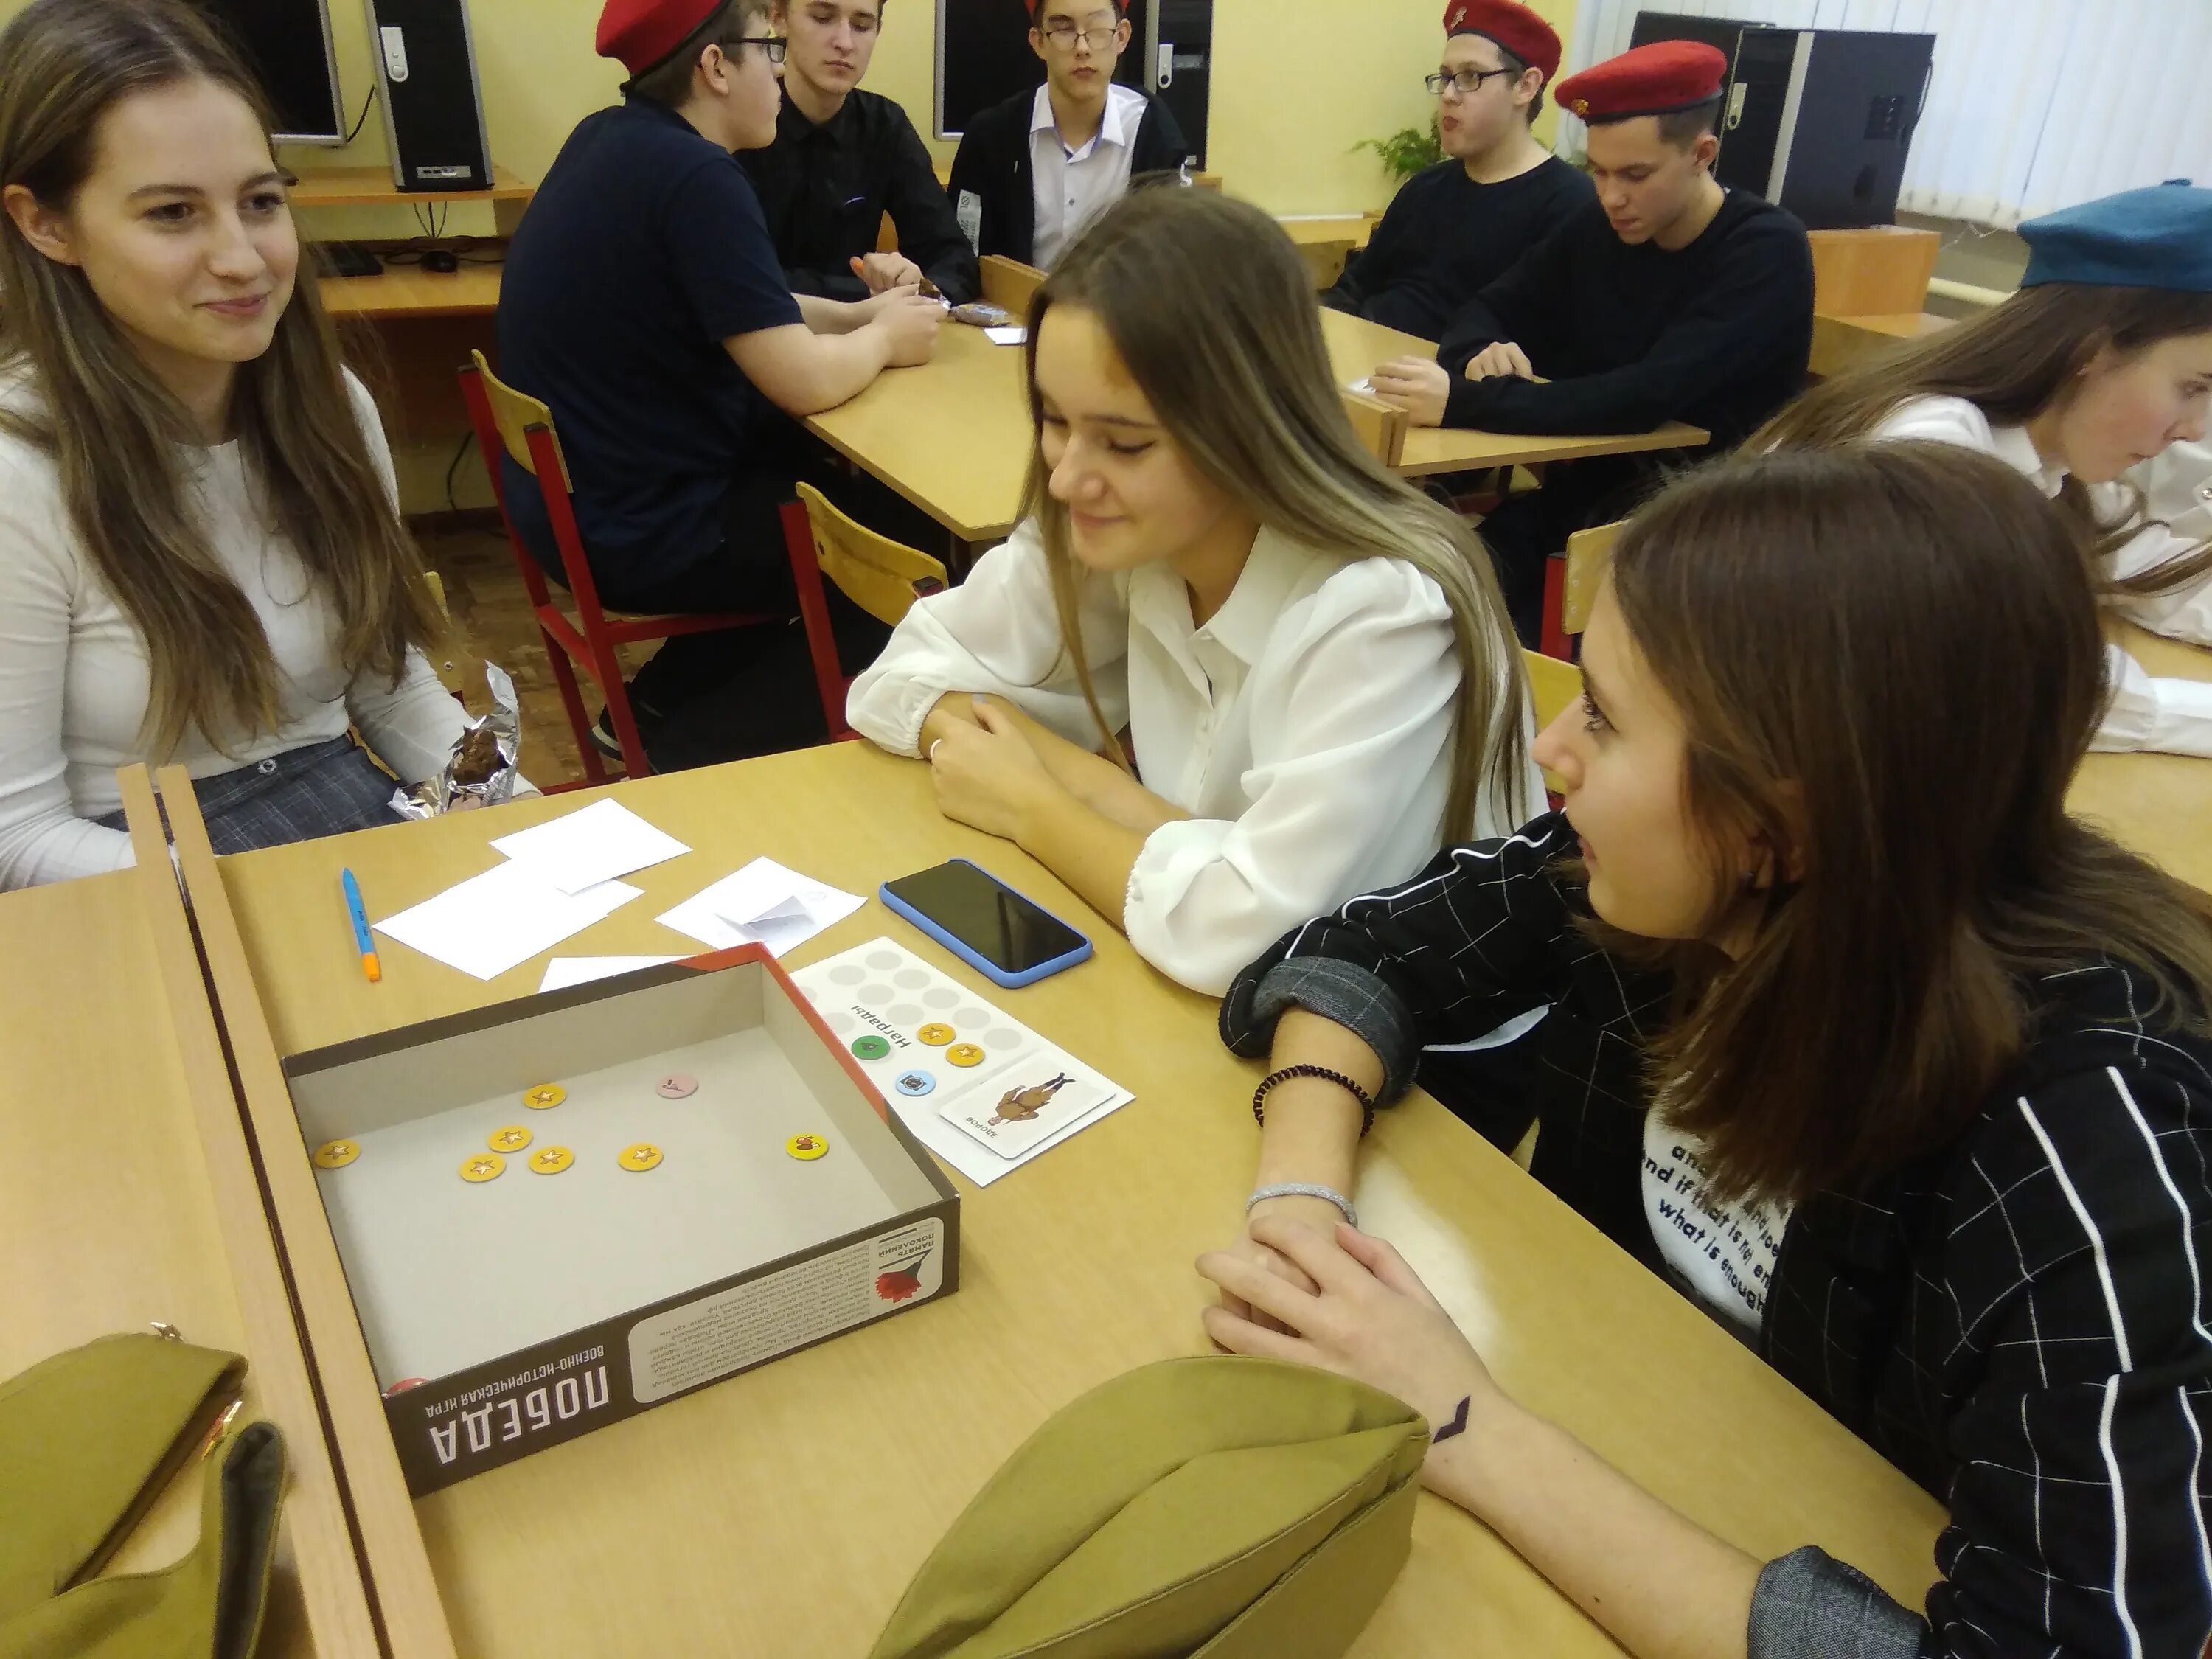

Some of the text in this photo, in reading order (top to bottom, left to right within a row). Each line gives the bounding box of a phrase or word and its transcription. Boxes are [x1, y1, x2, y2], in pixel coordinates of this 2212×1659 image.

[849, 1005, 912, 1049] Награды
[966, 1116, 998, 1138] ЗДОРОВ
[1641, 1151, 1674, 1183] nd
[1675, 1175, 1694, 1194] if
[1728, 1220, 1742, 1242] is
[878, 1232, 935, 1258] ПОКОЛЕНИЙ
[897, 1239, 935, 1258] ПАМЯТЬ
[1658, 1197, 1765, 1312] what is enough
[425, 1344, 605, 1419] ВОЕННО-ИСТОРИЧЕСКАЯ ИГРА
[429, 1366, 610, 1464] ПОБЕДА
